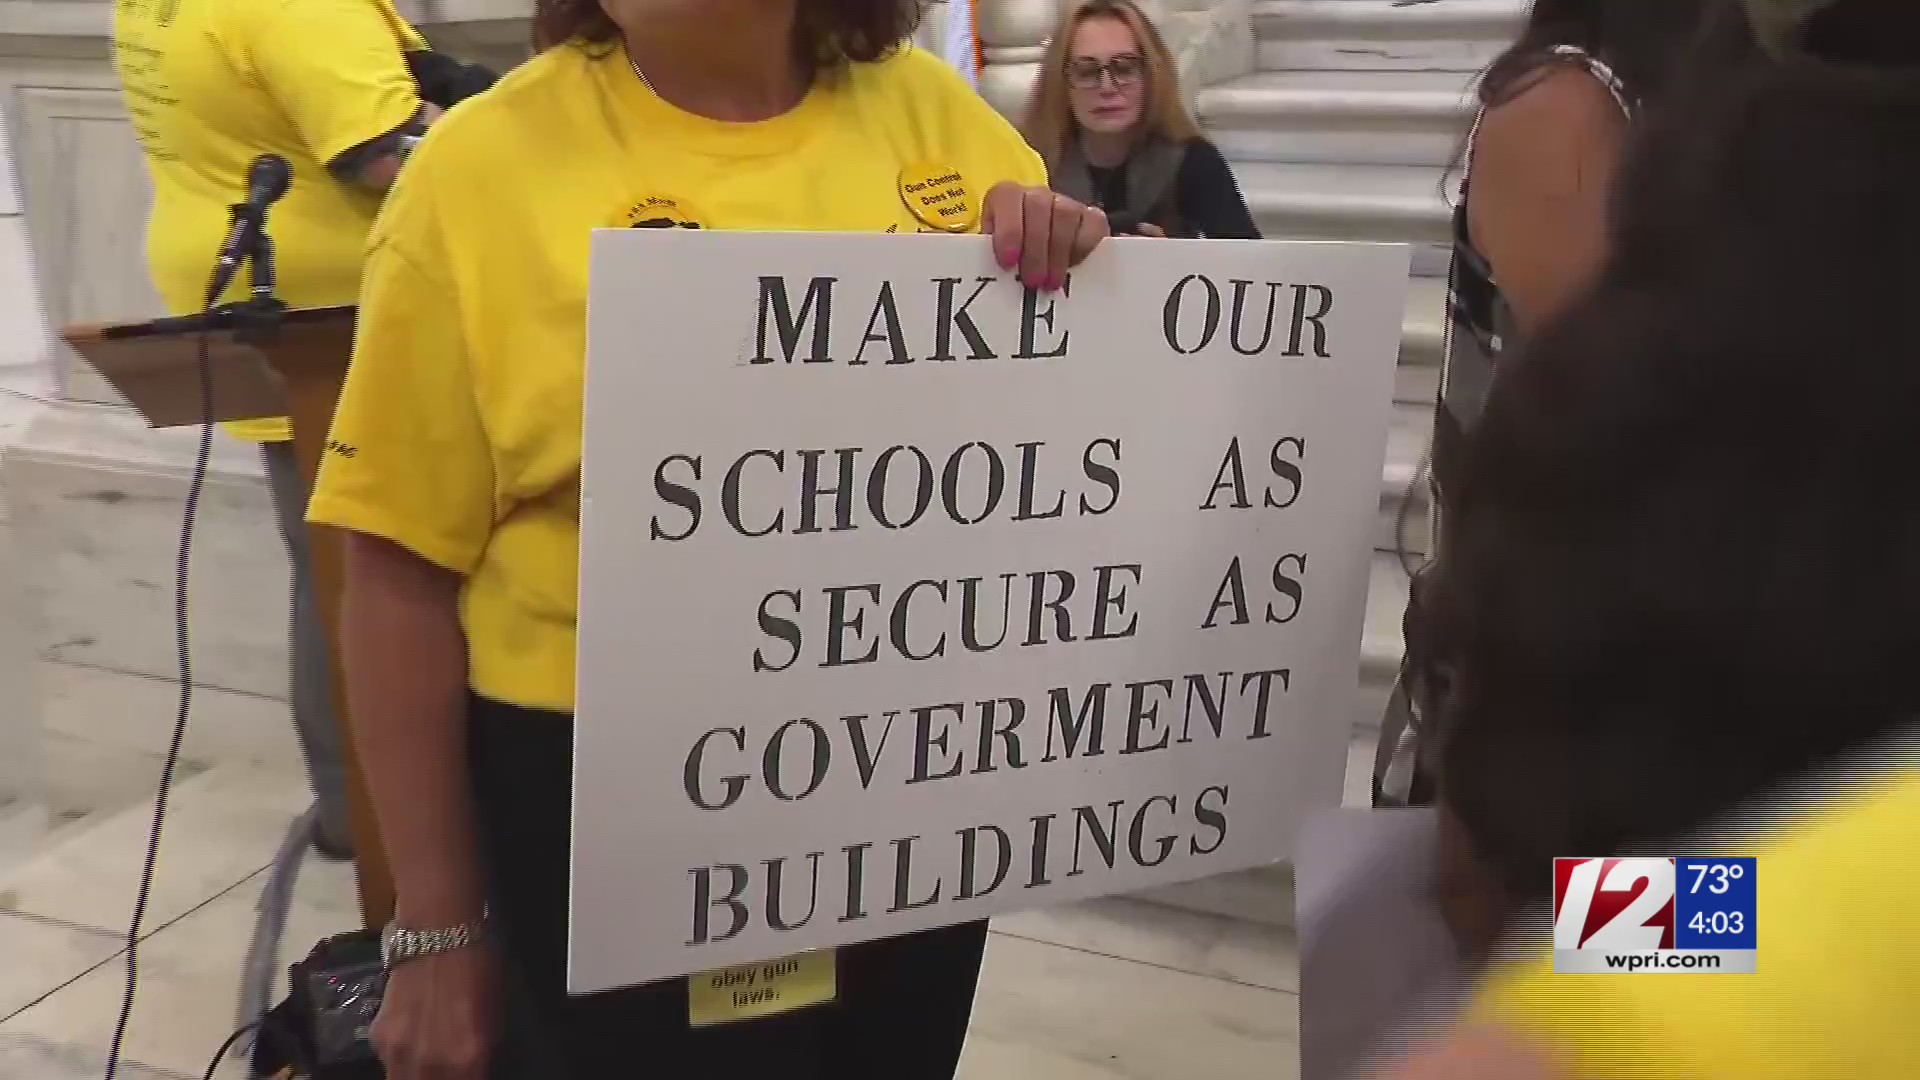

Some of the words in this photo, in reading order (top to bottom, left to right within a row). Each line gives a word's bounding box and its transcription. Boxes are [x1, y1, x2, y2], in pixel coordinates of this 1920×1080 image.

[905, 178, 925, 194] Gun
[926, 171, 963, 189] Control
[920, 190, 945, 207] Does
[946, 185, 965, 200] Not
[937, 202, 968, 218] Work!
[750, 275, 1071, 366] MAKE
[1162, 274, 1334, 359] OUR
[650, 437, 1122, 541] SCHOOLS
[1199, 436, 1306, 512] AS
[752, 563, 1143, 674] SECURE
[1200, 552, 1308, 630] AS
[682, 669, 1291, 811] GOVERMENT
[685, 785, 1231, 948] BUILDINGS
[711, 966, 757, 988] obey
[763, 960, 798, 982] gun
[732, 987, 780, 1009] laws.
